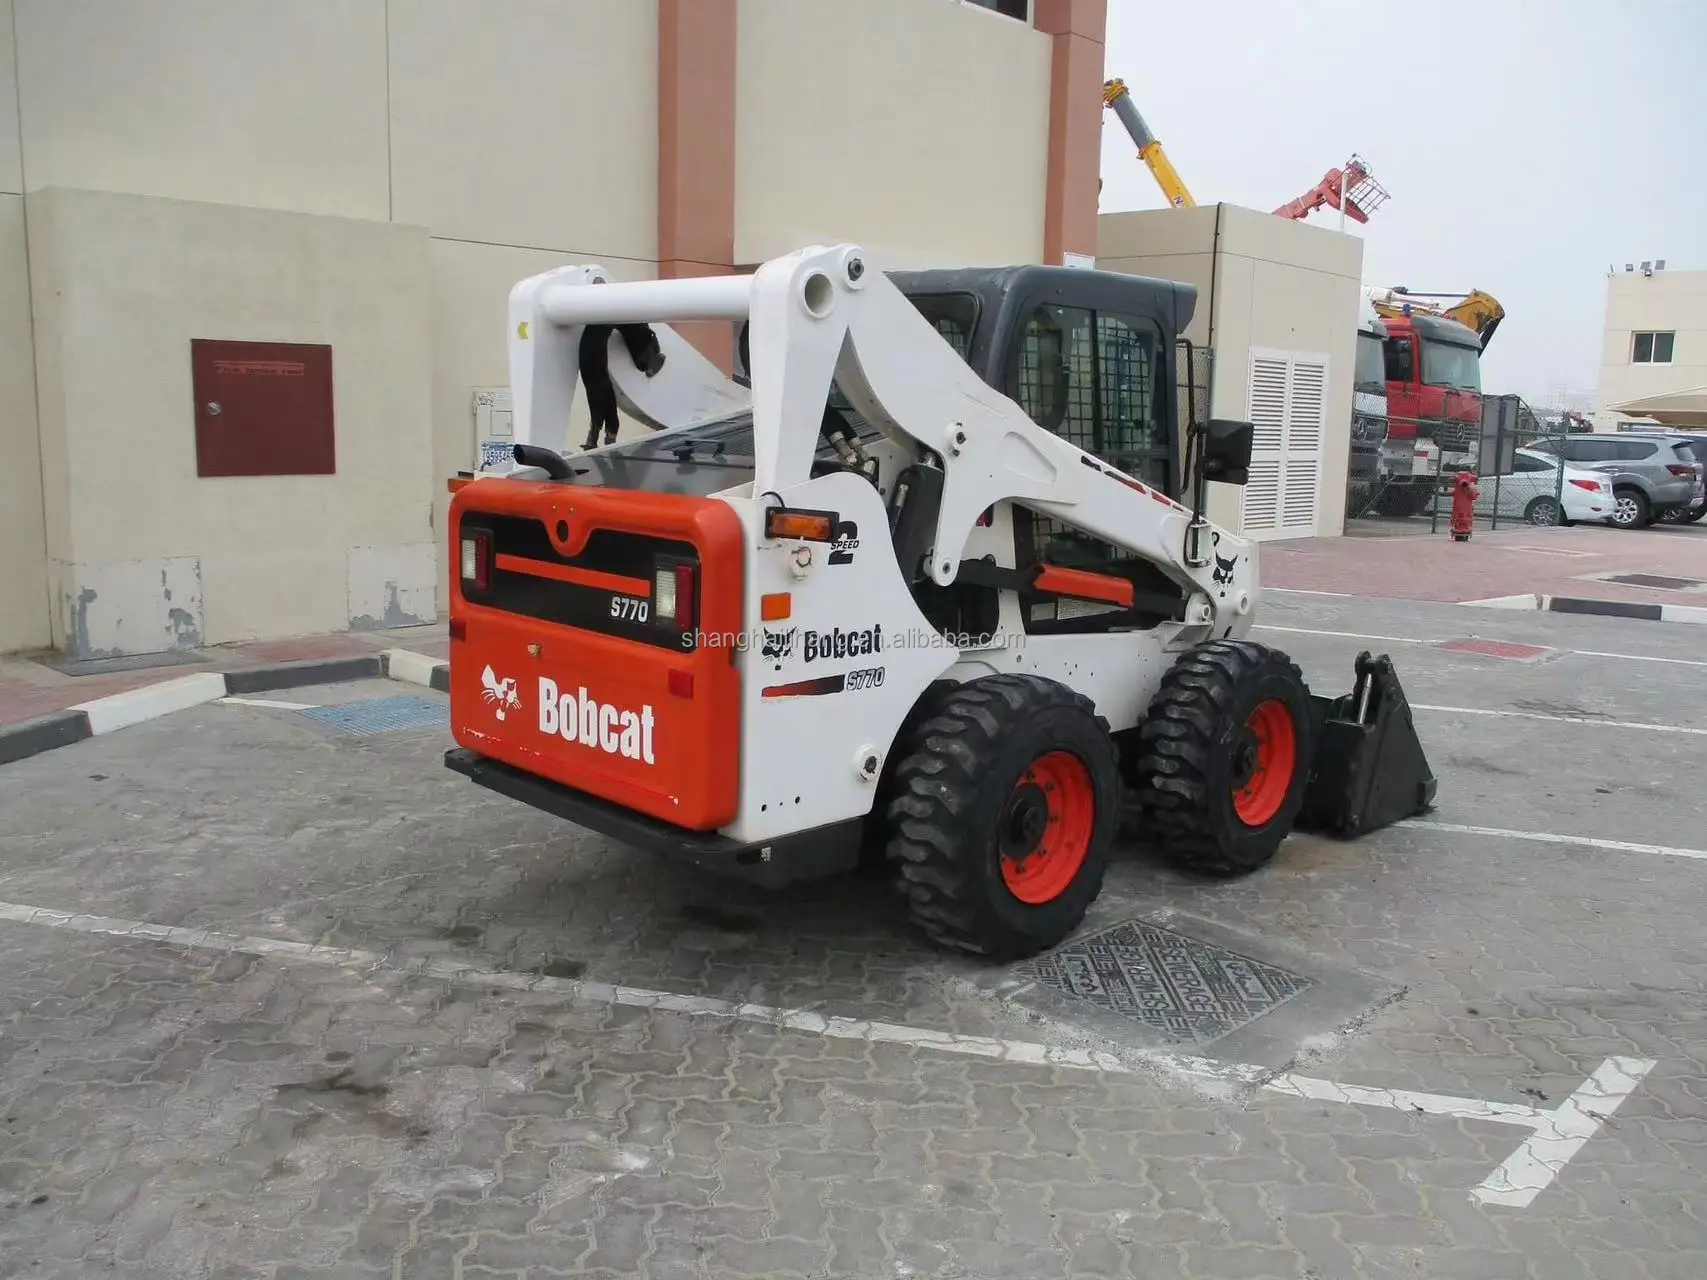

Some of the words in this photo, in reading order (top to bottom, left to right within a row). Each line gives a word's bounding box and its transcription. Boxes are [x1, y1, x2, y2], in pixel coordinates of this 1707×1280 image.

[831, 540, 859, 550] SPEED
[610, 596, 649, 623] S770
[804, 624, 881, 663] Bobcat
[846, 667, 885, 690] S770
[538, 676, 654, 765] Bobcat
